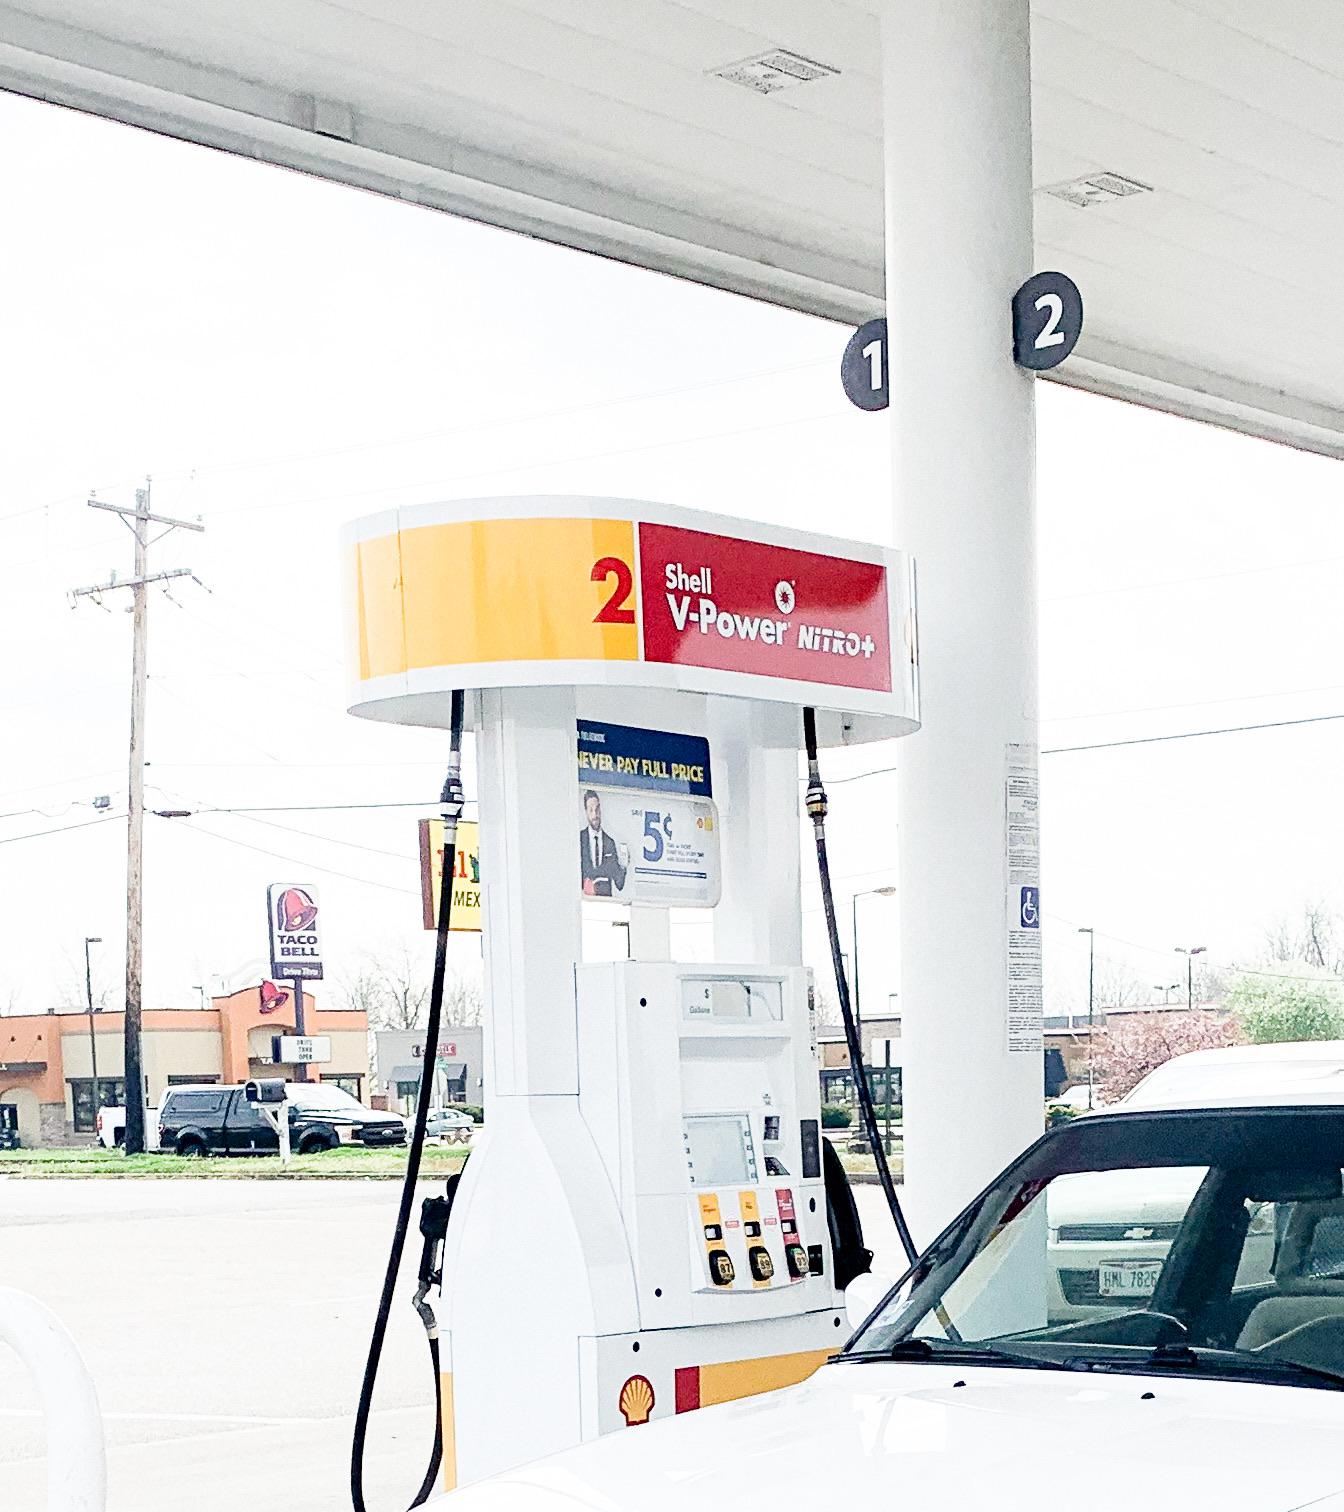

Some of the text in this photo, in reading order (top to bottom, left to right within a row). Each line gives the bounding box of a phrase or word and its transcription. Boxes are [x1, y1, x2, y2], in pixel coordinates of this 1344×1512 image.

[1034, 293, 1066, 349] 2
[862, 339, 883, 391] 1
[590, 556, 636, 624] 2
[665, 562, 712, 595] Shell
[666, 593, 788, 646] V-Power
[617, 756, 640, 774] PAY
[642, 759, 670, 779] FULL
[671, 763, 704, 783] PRICE
[277, 934, 318, 945] TACO
[280, 946, 319, 957] BELL
[720, 1263, 731, 1274] 87
[760, 1259, 770, 1270] 89
